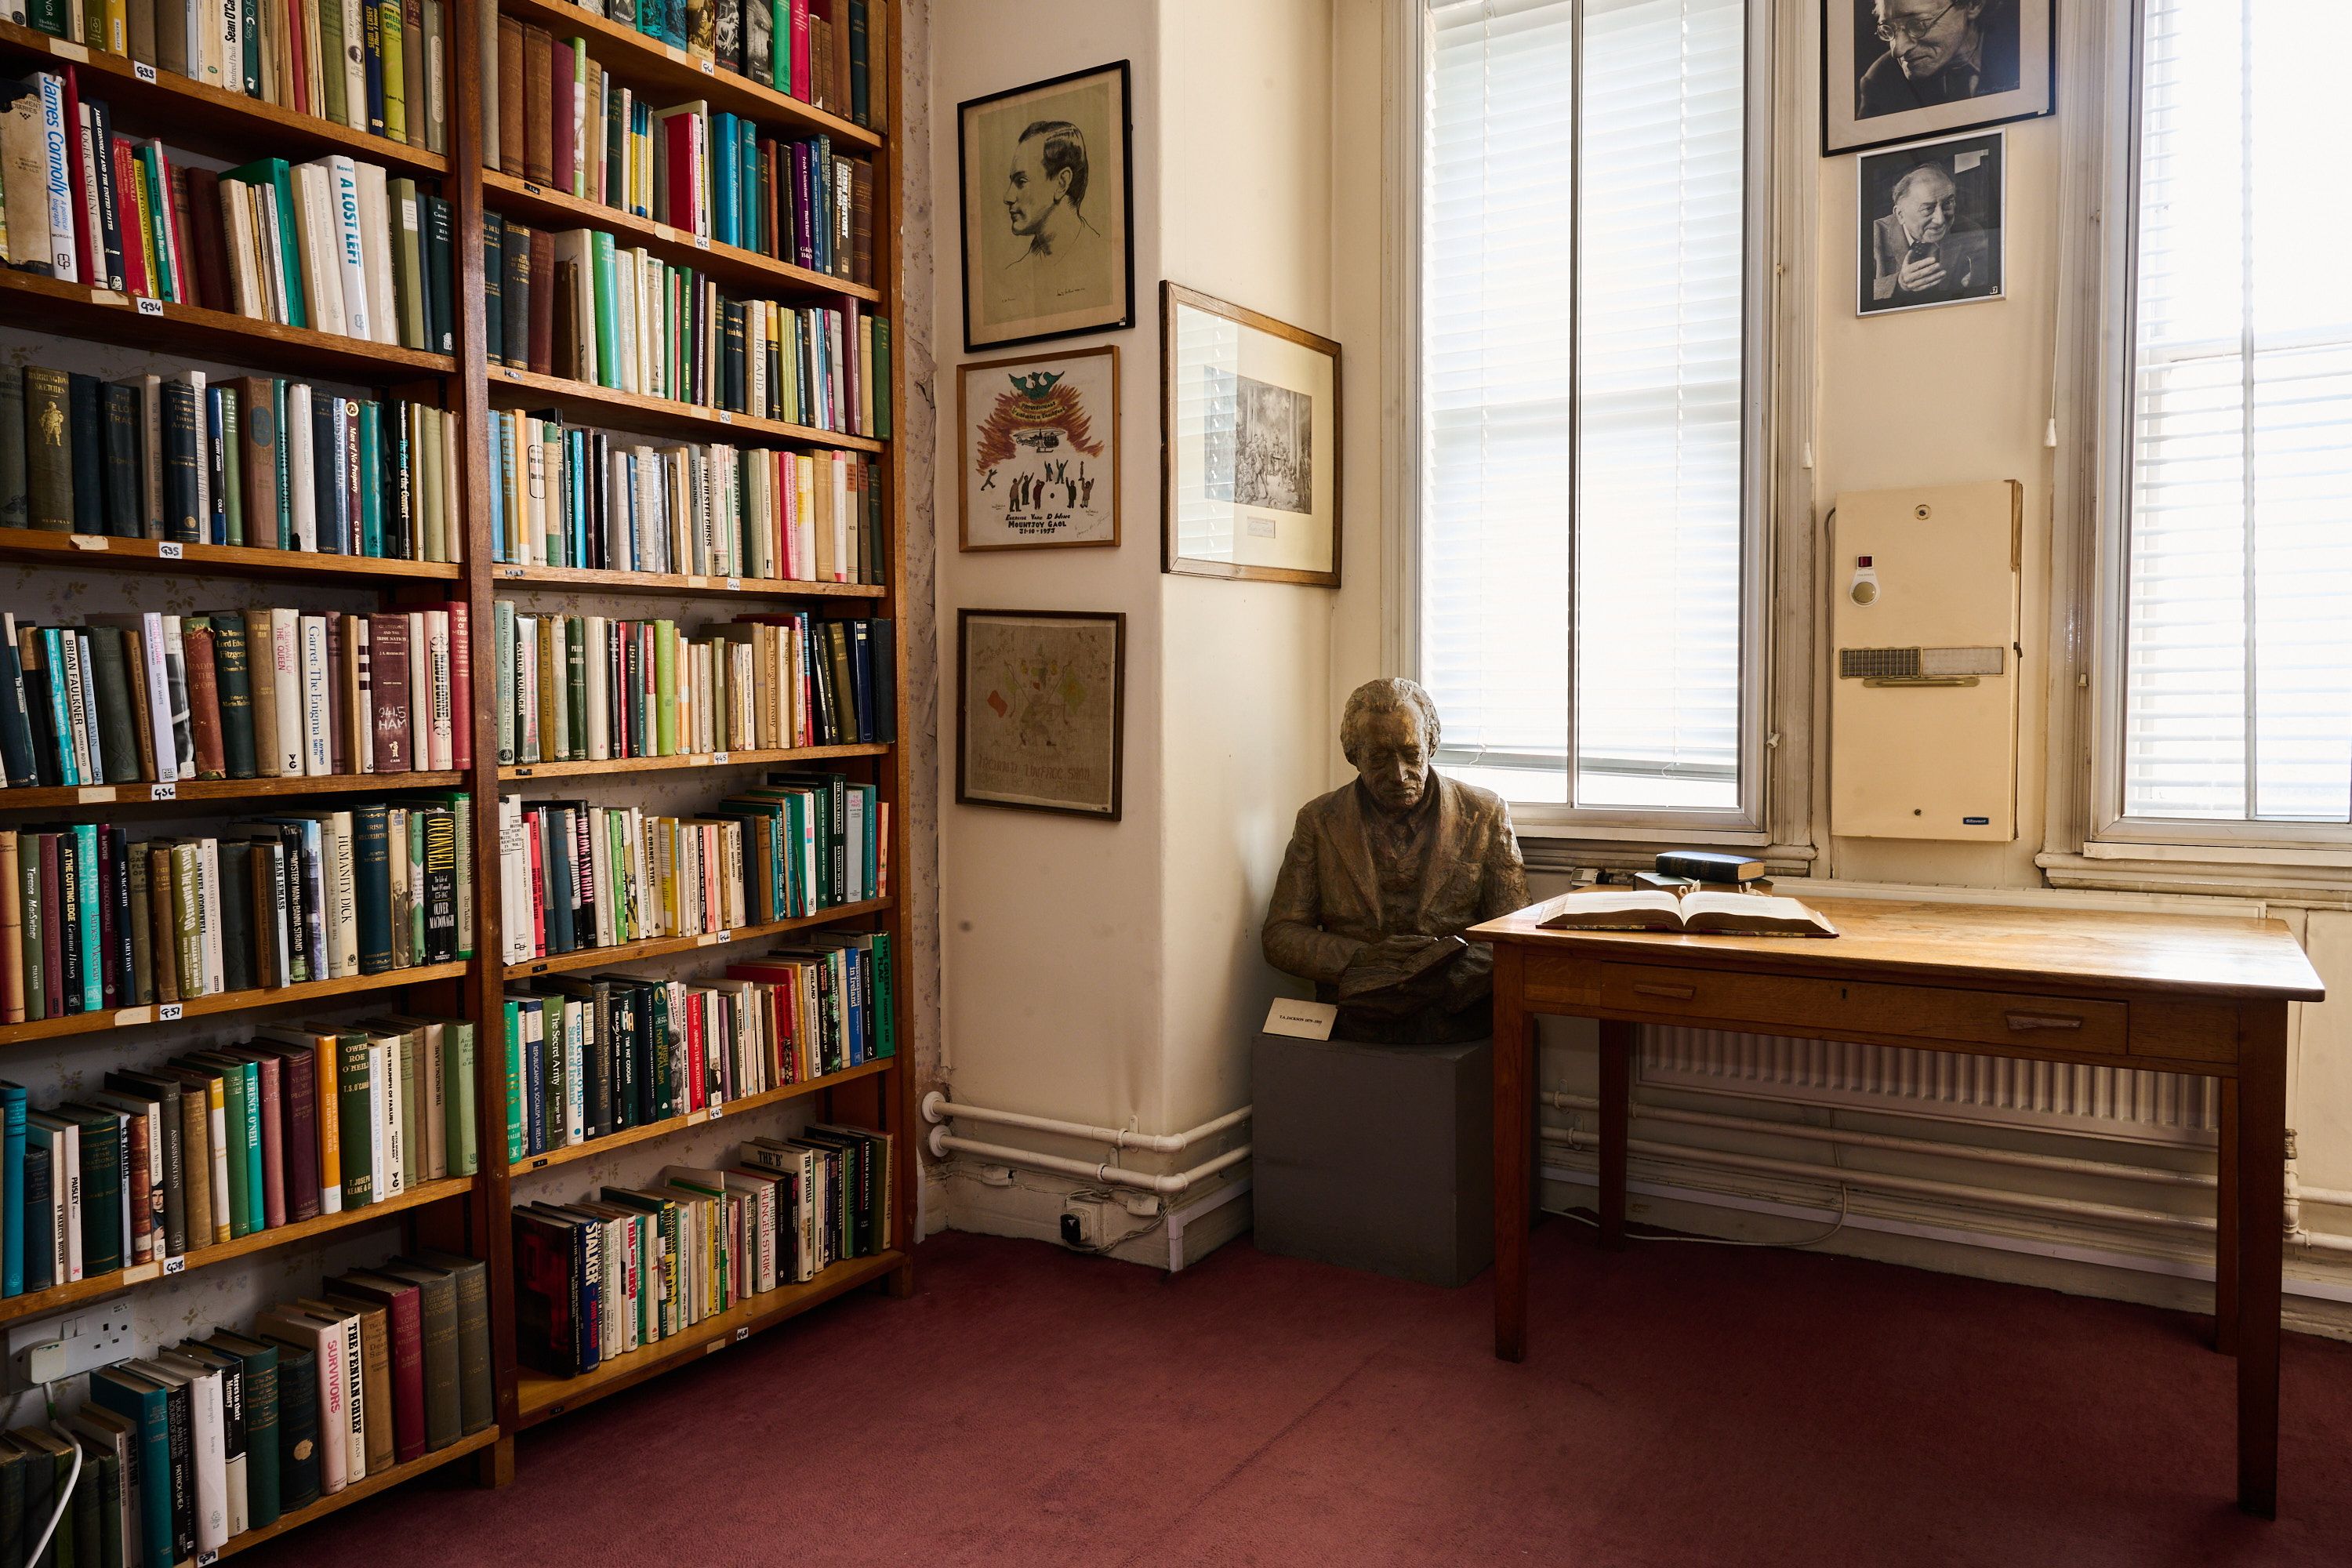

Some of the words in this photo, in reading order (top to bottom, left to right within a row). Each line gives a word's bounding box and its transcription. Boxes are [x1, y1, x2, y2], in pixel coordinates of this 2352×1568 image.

[384, 13, 401, 24] GREEN
[136, 67, 154, 79] G33
[43, 75, 62, 127] James
[80, 125, 91, 159] ROGER
[96, 127, 105, 159] CONNOLLY
[47, 130, 67, 198] Connolly
[124, 146, 133, 169] JAMES
[85, 165, 97, 218] CASEMENT
[126, 169, 137, 202] CONNOLLY
[339, 176, 353, 188] A
[50, 198, 61, 228] biography
[340, 191, 358, 231] LOST
[344, 232, 361, 268] LEFT
[141, 301, 161, 312] G34
[34, 383, 65, 394] SKETCHES
[349, 443, 357, 452] of
[350, 452, 358, 463] No
[399, 439, 408, 452] The
[399, 452, 408, 468] Zeal
[350, 463, 358, 492] Property
[400, 475, 408, 488] the
[690, 459, 699, 507] GUN-RUNNING
[280, 473, 290, 513] COOKE
[400, 490, 410, 518] Convert
[161, 546, 180, 556] G35
[151, 619, 160, 639] JOHN
[64, 639, 77, 671] BRIAN
[154, 641, 162, 665] HUME
[276, 644, 285, 670] QUEEN
[308, 626, 321, 666] Garret:
[516, 641, 524, 673] CALTON
[82, 665, 89, 674] US
[542, 660, 549, 671] BY
[83, 675, 93, 697] THERE
[310, 667, 321, 691] The
[16, 687, 26, 713] Statesman
[67, 673, 84, 725] FAULKNER
[517, 674, 526, 716] YOUNGER
[86, 699, 95, 720] POLLY
[308, 693, 322, 735] Enigma
[379, 706, 406, 719] 941.5
[88, 721, 98, 746] DEVLIN
[378, 718, 407, 731] HAM
[715, 754, 727, 764] G45
[154, 787, 175, 800] G36
[64, 848, 72, 858] AT
[180, 846, 192, 871] FORTH
[426, 818, 453, 873] O'CONNELL
[64, 858, 73, 872] THE
[180, 870, 192, 886] THE
[337, 835, 350, 895] HUMANITY
[27, 867, 36, 894] Terence
[65, 873, 74, 902] CUTTING
[181, 884, 195, 917] BANNERS
[340, 898, 351, 924] DICK
[434, 902, 449, 915] OLIVER
[26, 898, 37, 938] MacSwiney
[89, 911, 100, 941] James
[183, 917, 195, 931] GO
[429, 914, 454, 929] MACDONAGH
[67, 953, 76, 978] Hussey
[91, 943, 101, 981] Meenan
[551, 1010, 560, 1029] The
[346, 1043, 368, 1053] OWEN
[567, 1025, 575, 1056] States
[348, 1053, 365, 1063] ROE
[568, 1058, 575, 1067] of
[550, 1059, 560, 1085] Army
[246, 1076, 256, 1113] TERENCE
[506, 1073, 520, 1105] IRA
[248, 1116, 257, 1149] O'NEILL
[169, 1129, 180, 1189] ASSASSINATION
[757, 1150, 771, 1166] THE
[760, 1188, 769, 1237] HUNGER
[584, 1221, 598, 1286] STALKER
[166, 1260, 183, 1274] G38
[347, 1323, 358, 1347] THE
[327, 1340, 339, 1413] SURVIVORS
[348, 1349, 360, 1398] FENIAN
[223, 1380, 234, 1408] Memory
[350, 1397, 361, 1434] CHIEF
[169, 1425, 176, 1435] OF
